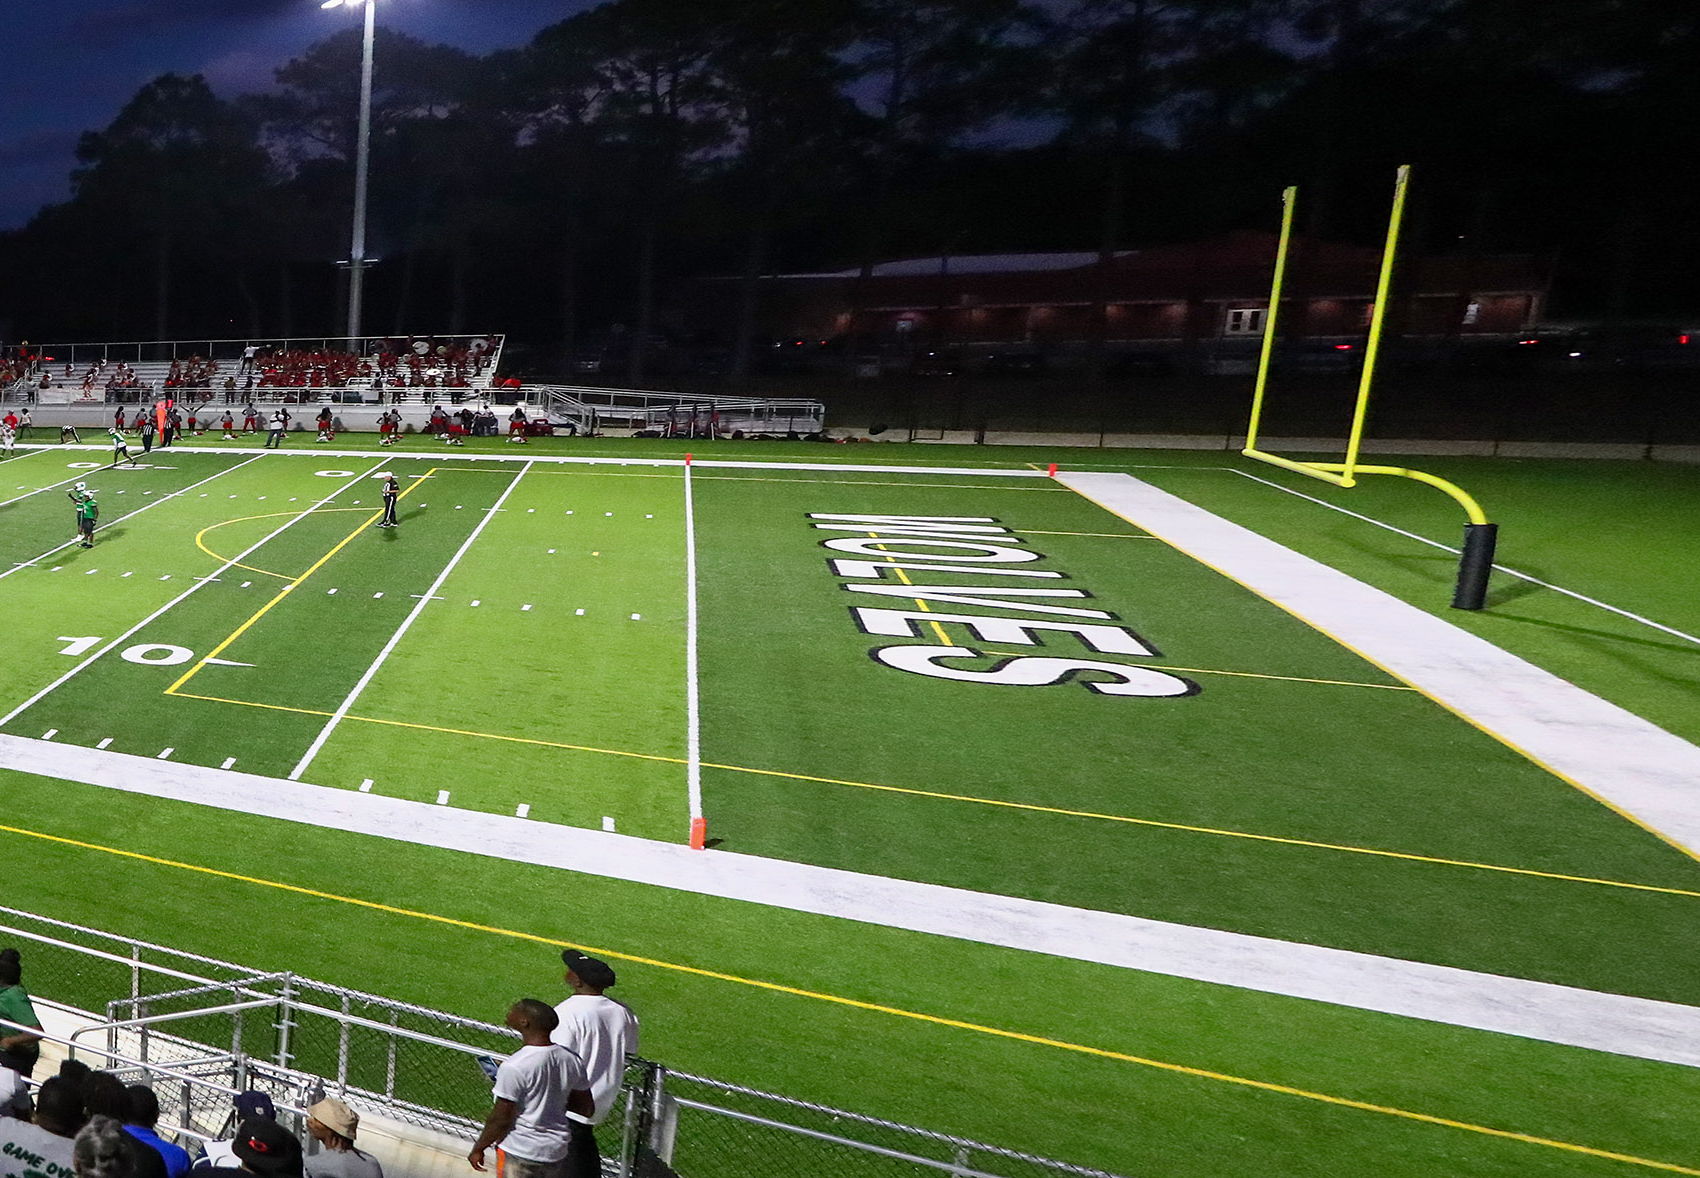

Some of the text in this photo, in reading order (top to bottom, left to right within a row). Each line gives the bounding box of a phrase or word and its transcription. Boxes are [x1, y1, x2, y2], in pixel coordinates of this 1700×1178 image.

[805, 512, 1202, 698] WOLVES
[56, 636, 195, 666] 10
[2, 1141, 79, 1178] GAME OVE
